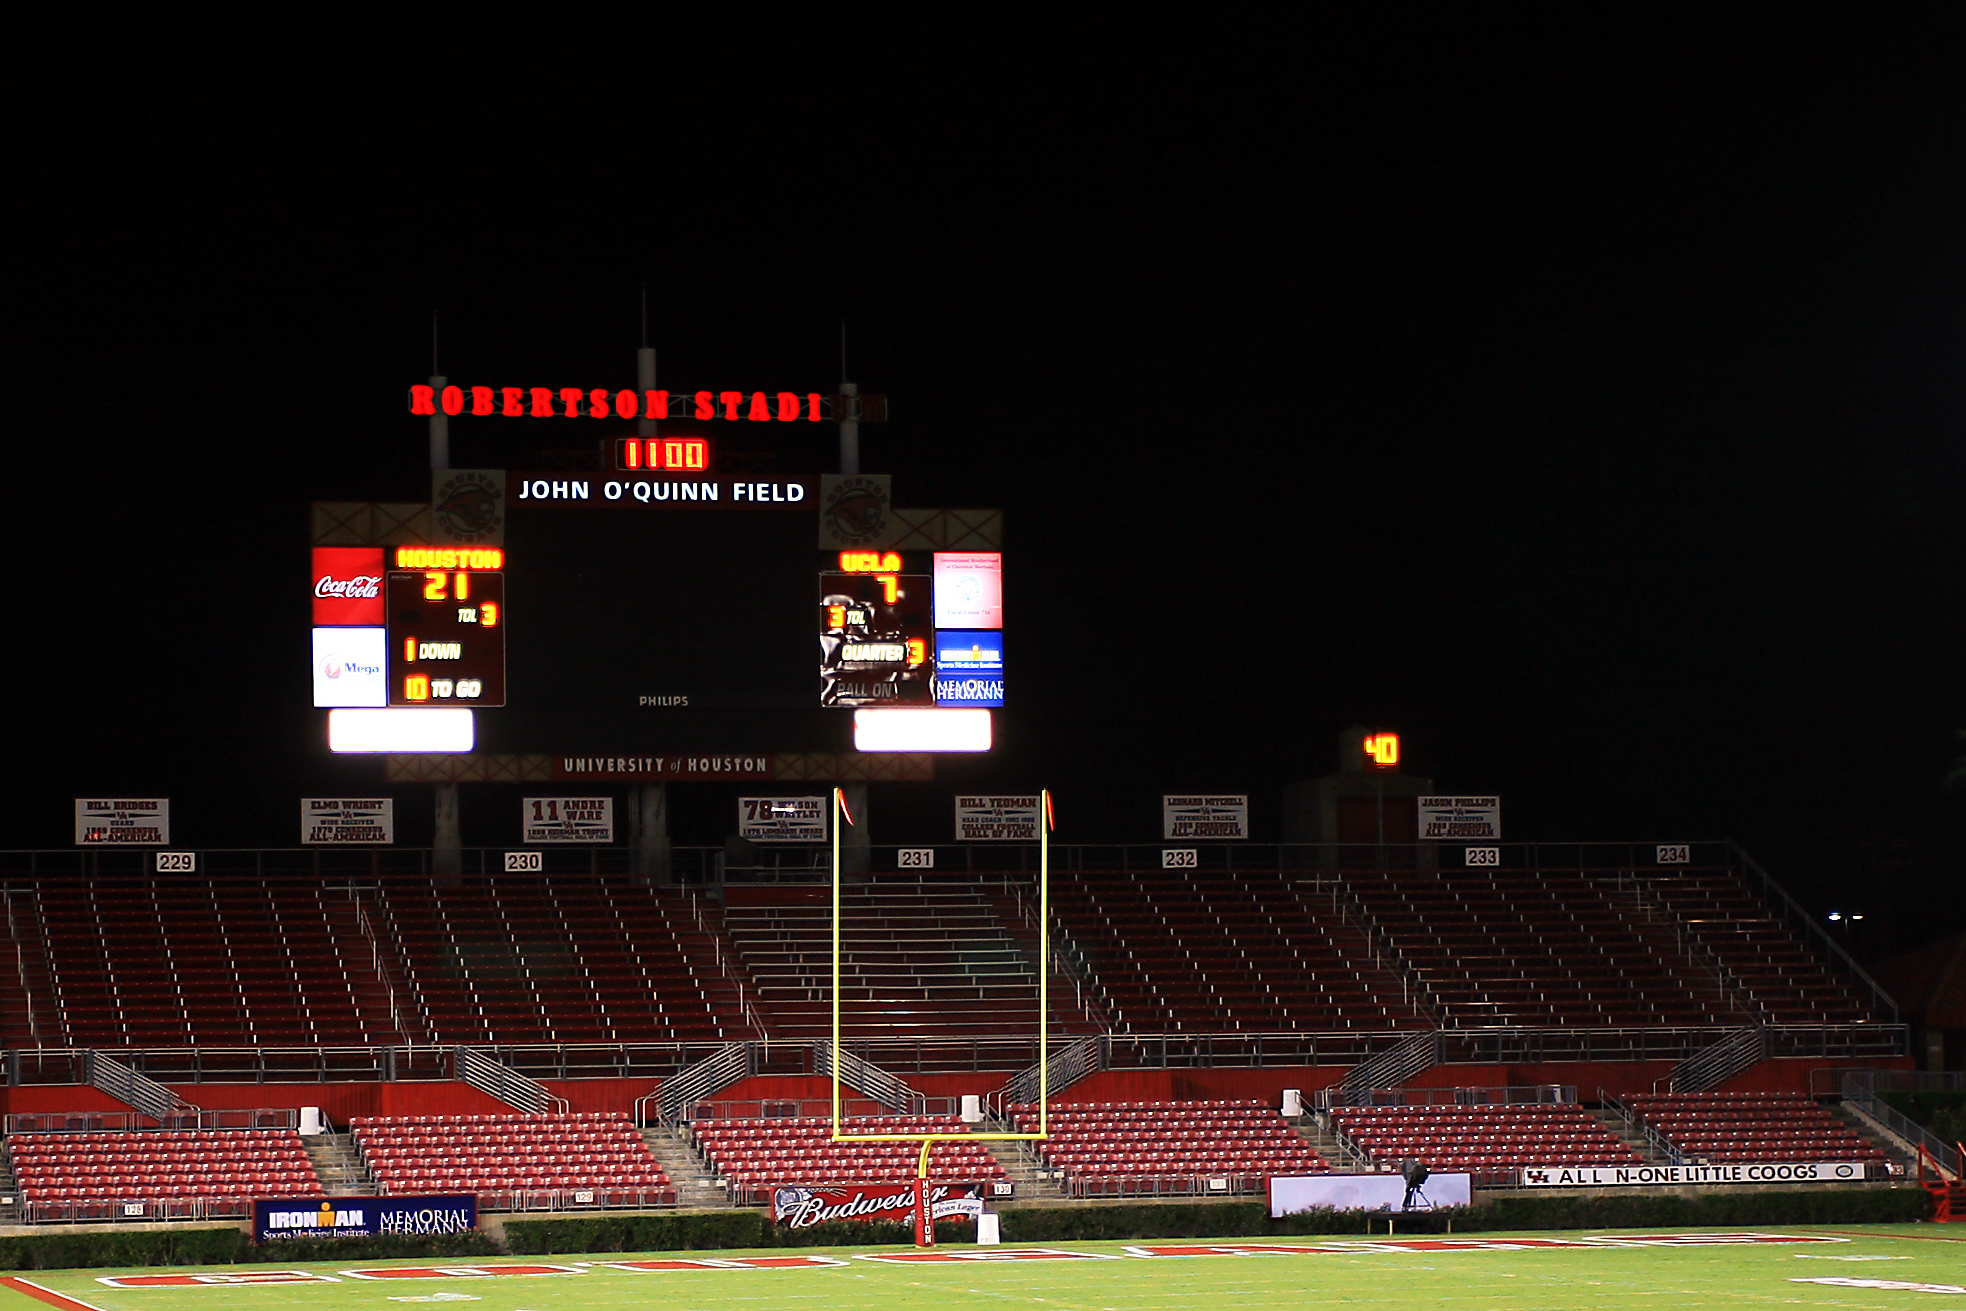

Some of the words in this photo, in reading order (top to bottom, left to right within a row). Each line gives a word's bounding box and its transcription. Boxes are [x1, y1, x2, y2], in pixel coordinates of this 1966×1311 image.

[410, 384, 669, 420] ROBERTSON
[519, 480, 589, 499] JOHN
[604, 481, 719, 503] O'QUINN
[733, 482, 805, 502] FIELD
[397, 547, 503, 569] HOUSTON
[842, 553, 902, 573] UCLA
[314, 575, 382, 599] Coca-Cola
[424, 572, 470, 601] 21
[876, 574, 898, 604] 7
[480, 602, 498, 627] 3
[828, 605, 846, 628] 3
[405, 637, 417, 663] 1
[419, 642, 462, 660] DOWN
[841, 643, 904, 662] QUARTER
[907, 639, 926, 665] 3
[345, 663, 379, 675] Mega
[405, 674, 430, 702] 10
[431, 680, 453, 698] TO
[456, 680, 482, 698] GO
[872, 682, 892, 698] ON
[937, 679, 1004, 692] MEMORIAL
[937, 688, 1004, 700] HERMANN
[639, 696, 689, 706] PHILIPS
[1364, 733, 1399, 766] 40
[564, 757, 664, 772] UNIVERSITY
[670, 757, 682, 774] of
[687, 757, 766, 773] HOUSTON
[310, 801, 339, 810] ELMO
[531, 800, 558, 821] 11
[563, 800, 605, 810] ANDRE
[744, 800, 773, 820] 78
[960, 798, 985, 808] BILL
[989, 798, 1036, 808] YEOMAN
[566, 810, 603, 821] WARE
[160, 855, 192, 870] 229
[508, 854, 539, 870] 230
[902, 851, 930, 866] 231
[1165, 851, 1195, 866] 232
[1468, 849, 1497, 864] 233
[1659, 847, 1687, 861] 234
[1559, 1169, 1602, 1184] ALL
[1616, 1167, 1680, 1183] N-ONE
[1686, 1166, 1741, 1182] LITTLE
[1748, 1164, 1817, 1180] COOGS
[269, 1202, 363, 1228] IRONMAN
[380, 1208, 469, 1224] MEMORIAL
[782, 1185, 948, 1228] Budweisr
[922, 1180, 932, 1243] HOUSTON
